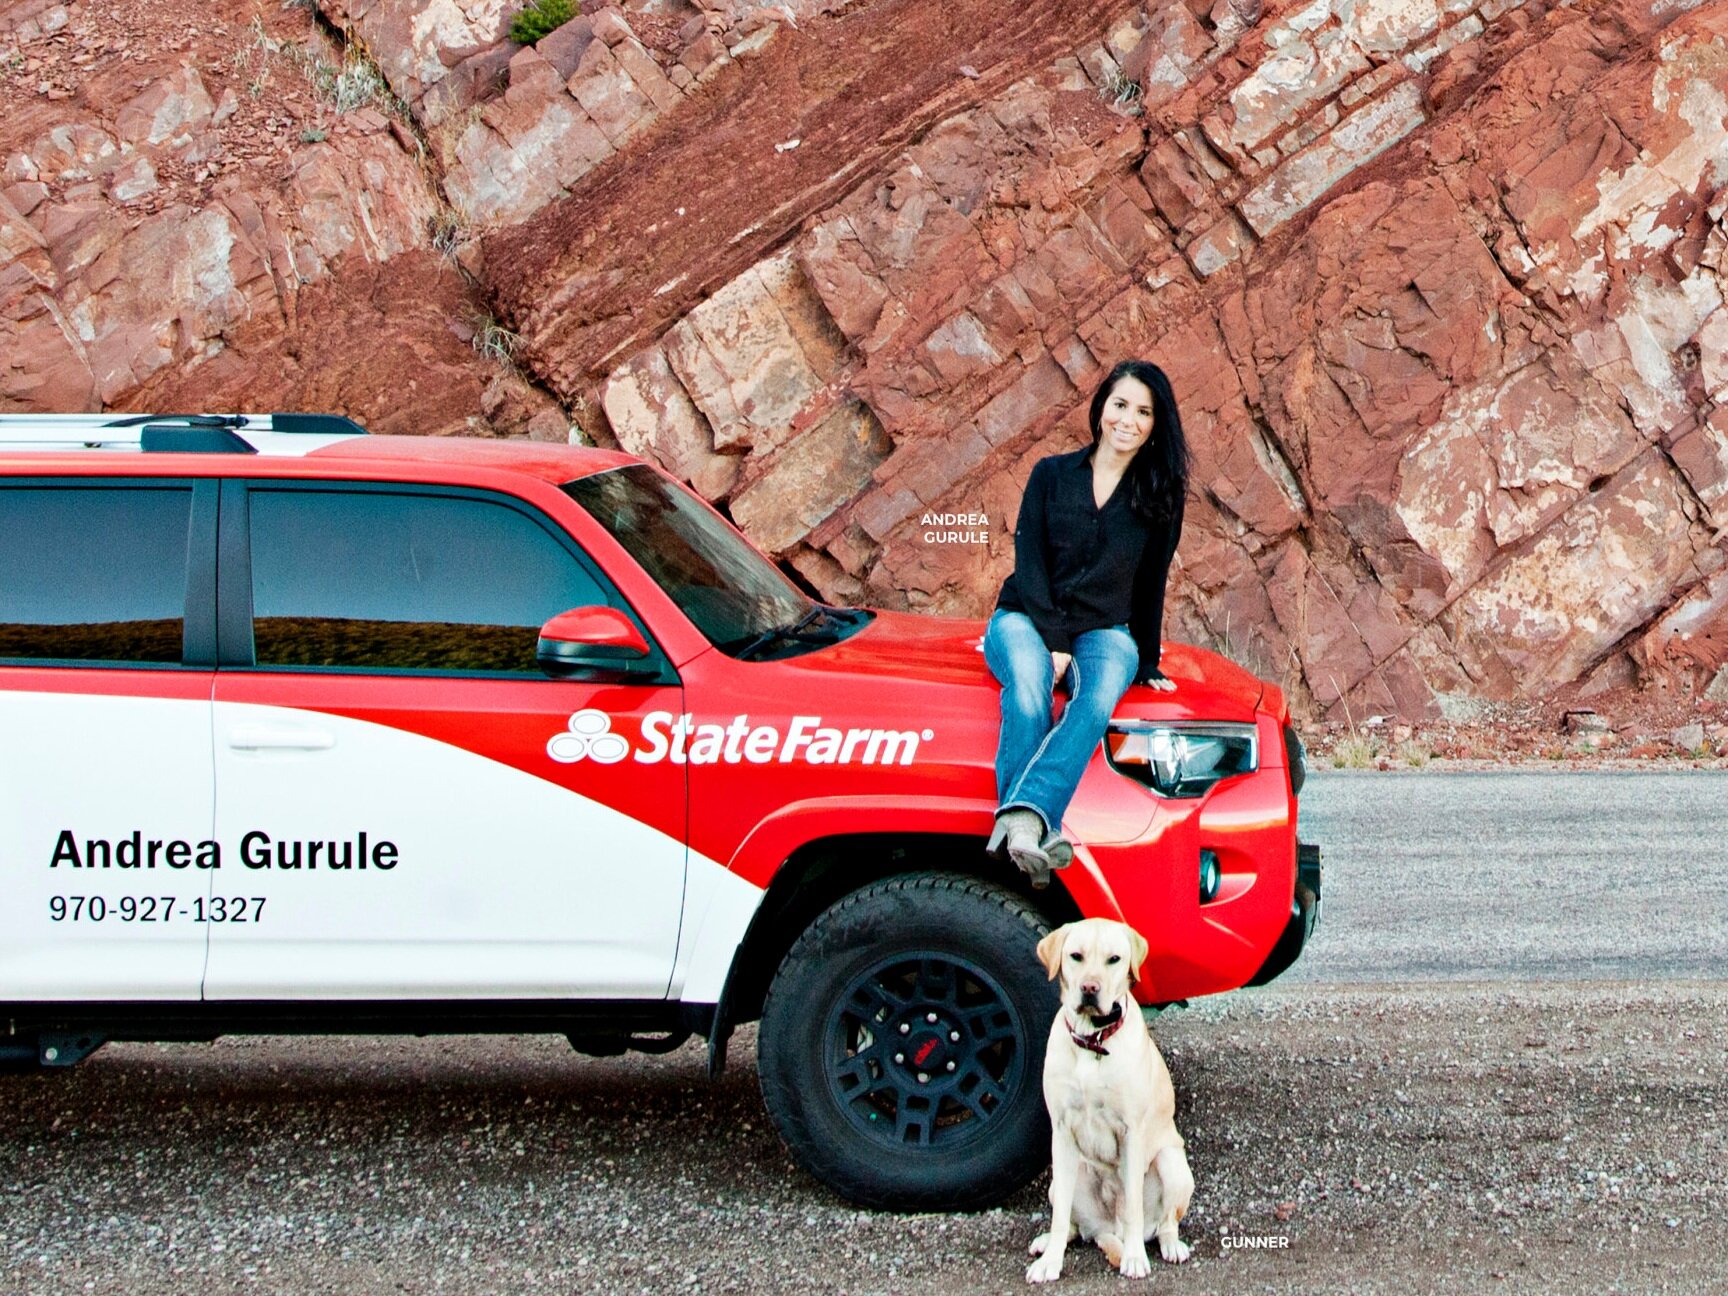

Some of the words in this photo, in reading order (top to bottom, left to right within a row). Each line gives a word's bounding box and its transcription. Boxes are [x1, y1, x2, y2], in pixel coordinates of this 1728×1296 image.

[50, 830, 221, 869] Andrea
[240, 831, 399, 870] Gurule
[49, 896, 267, 923] 970-927-1327
